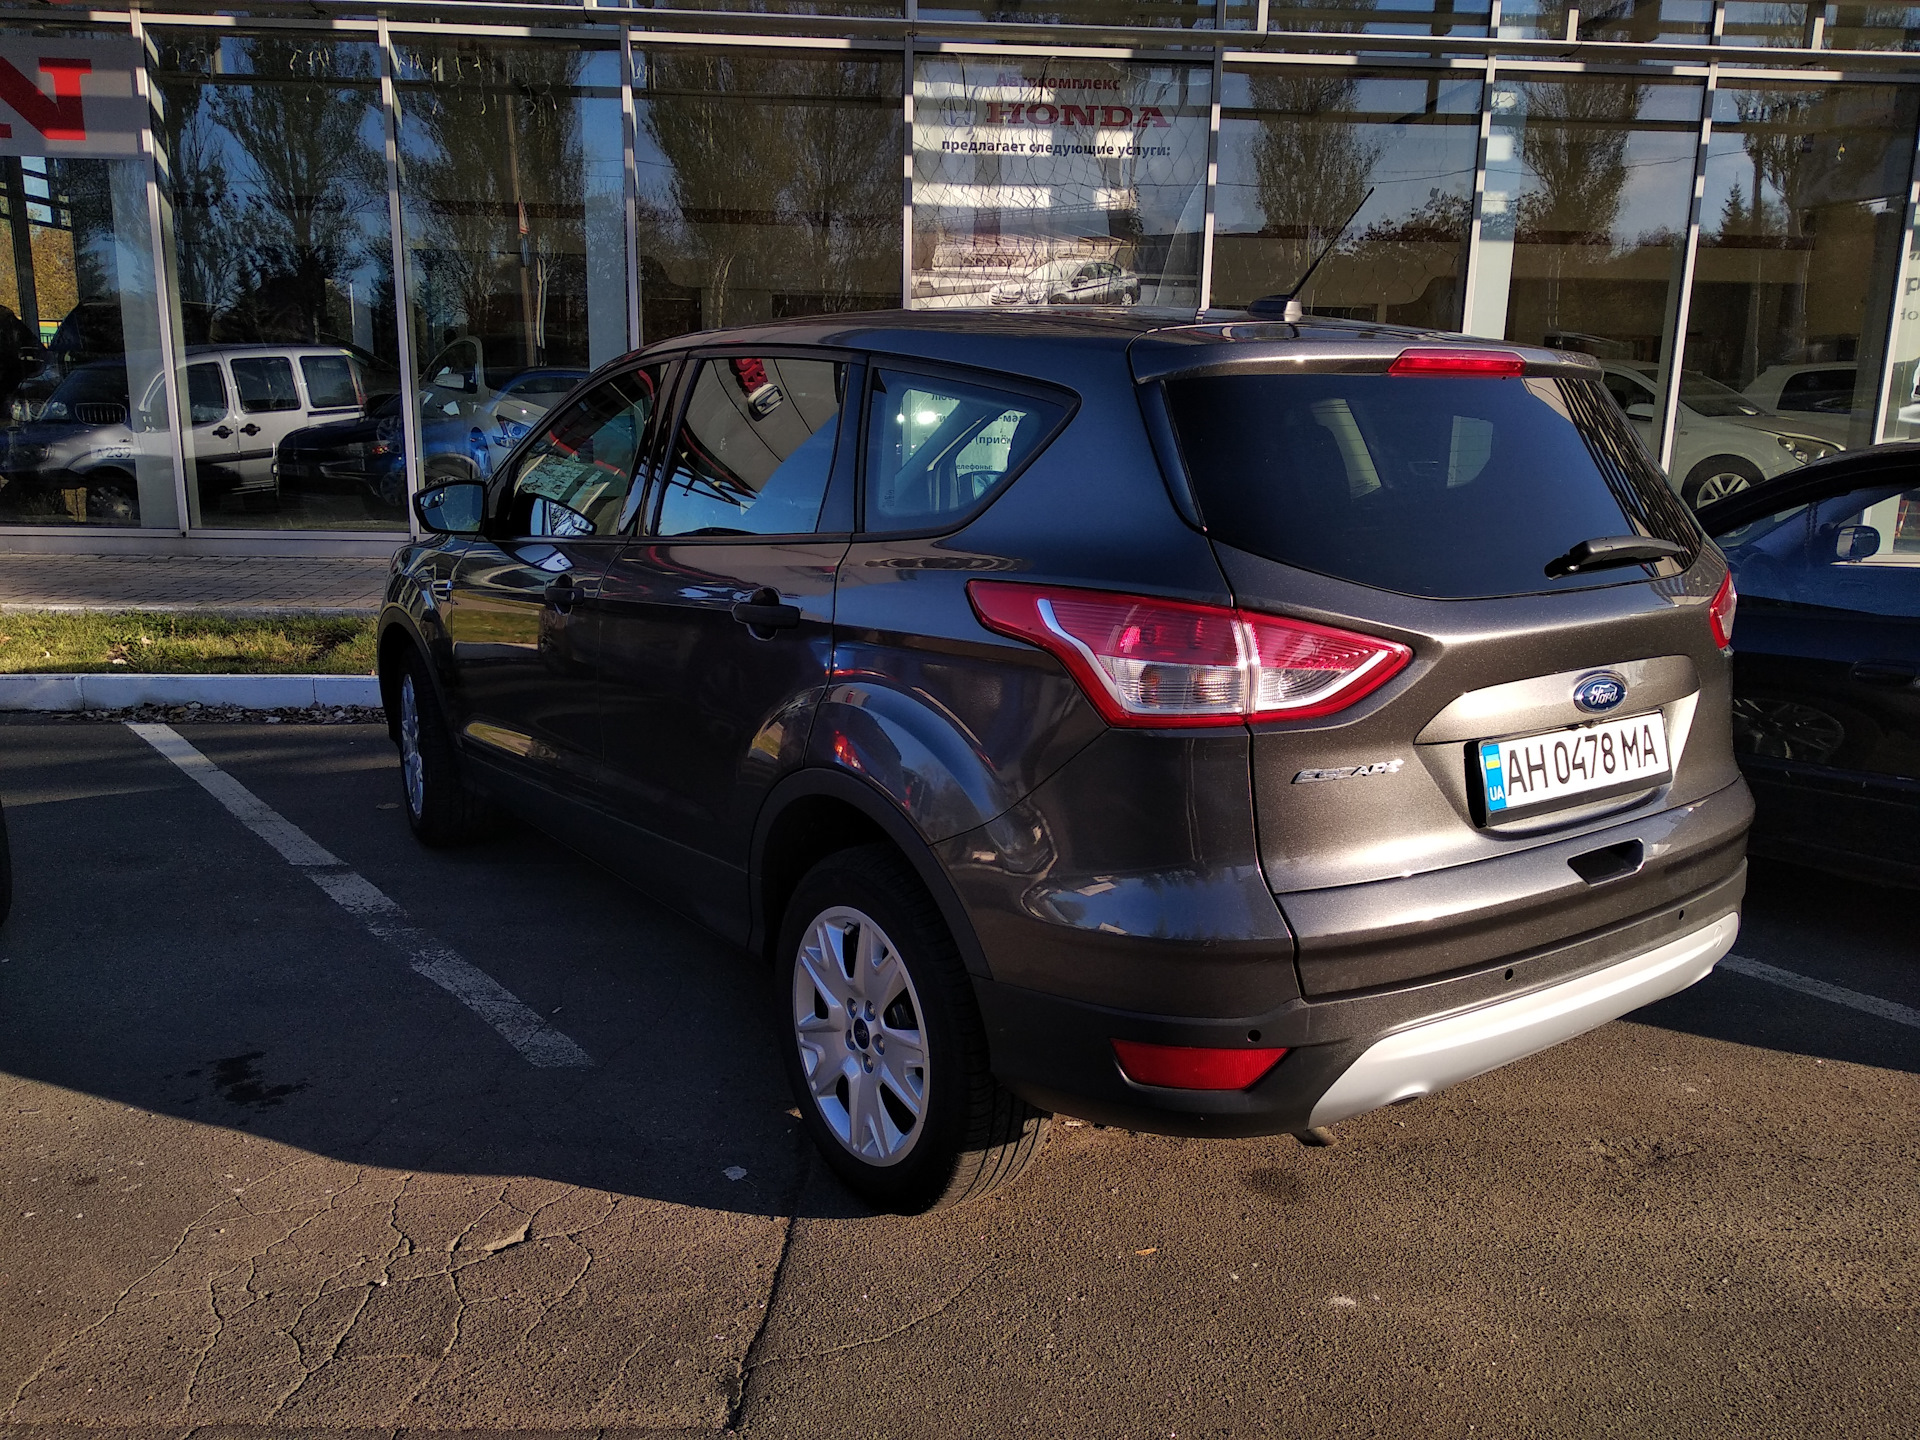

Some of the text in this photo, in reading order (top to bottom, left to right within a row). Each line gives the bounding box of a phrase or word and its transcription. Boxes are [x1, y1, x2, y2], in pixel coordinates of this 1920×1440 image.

[996, 73, 1121, 91] Автокомплекс
[986, 102, 1171, 128] HONDA
[942, 140, 1171, 159] предлагает следующие услуги:
[1588, 683, 1619, 705] Ford
[1508, 724, 1659, 796] AH 0478 MA
[1489, 785, 1505, 801] UA
